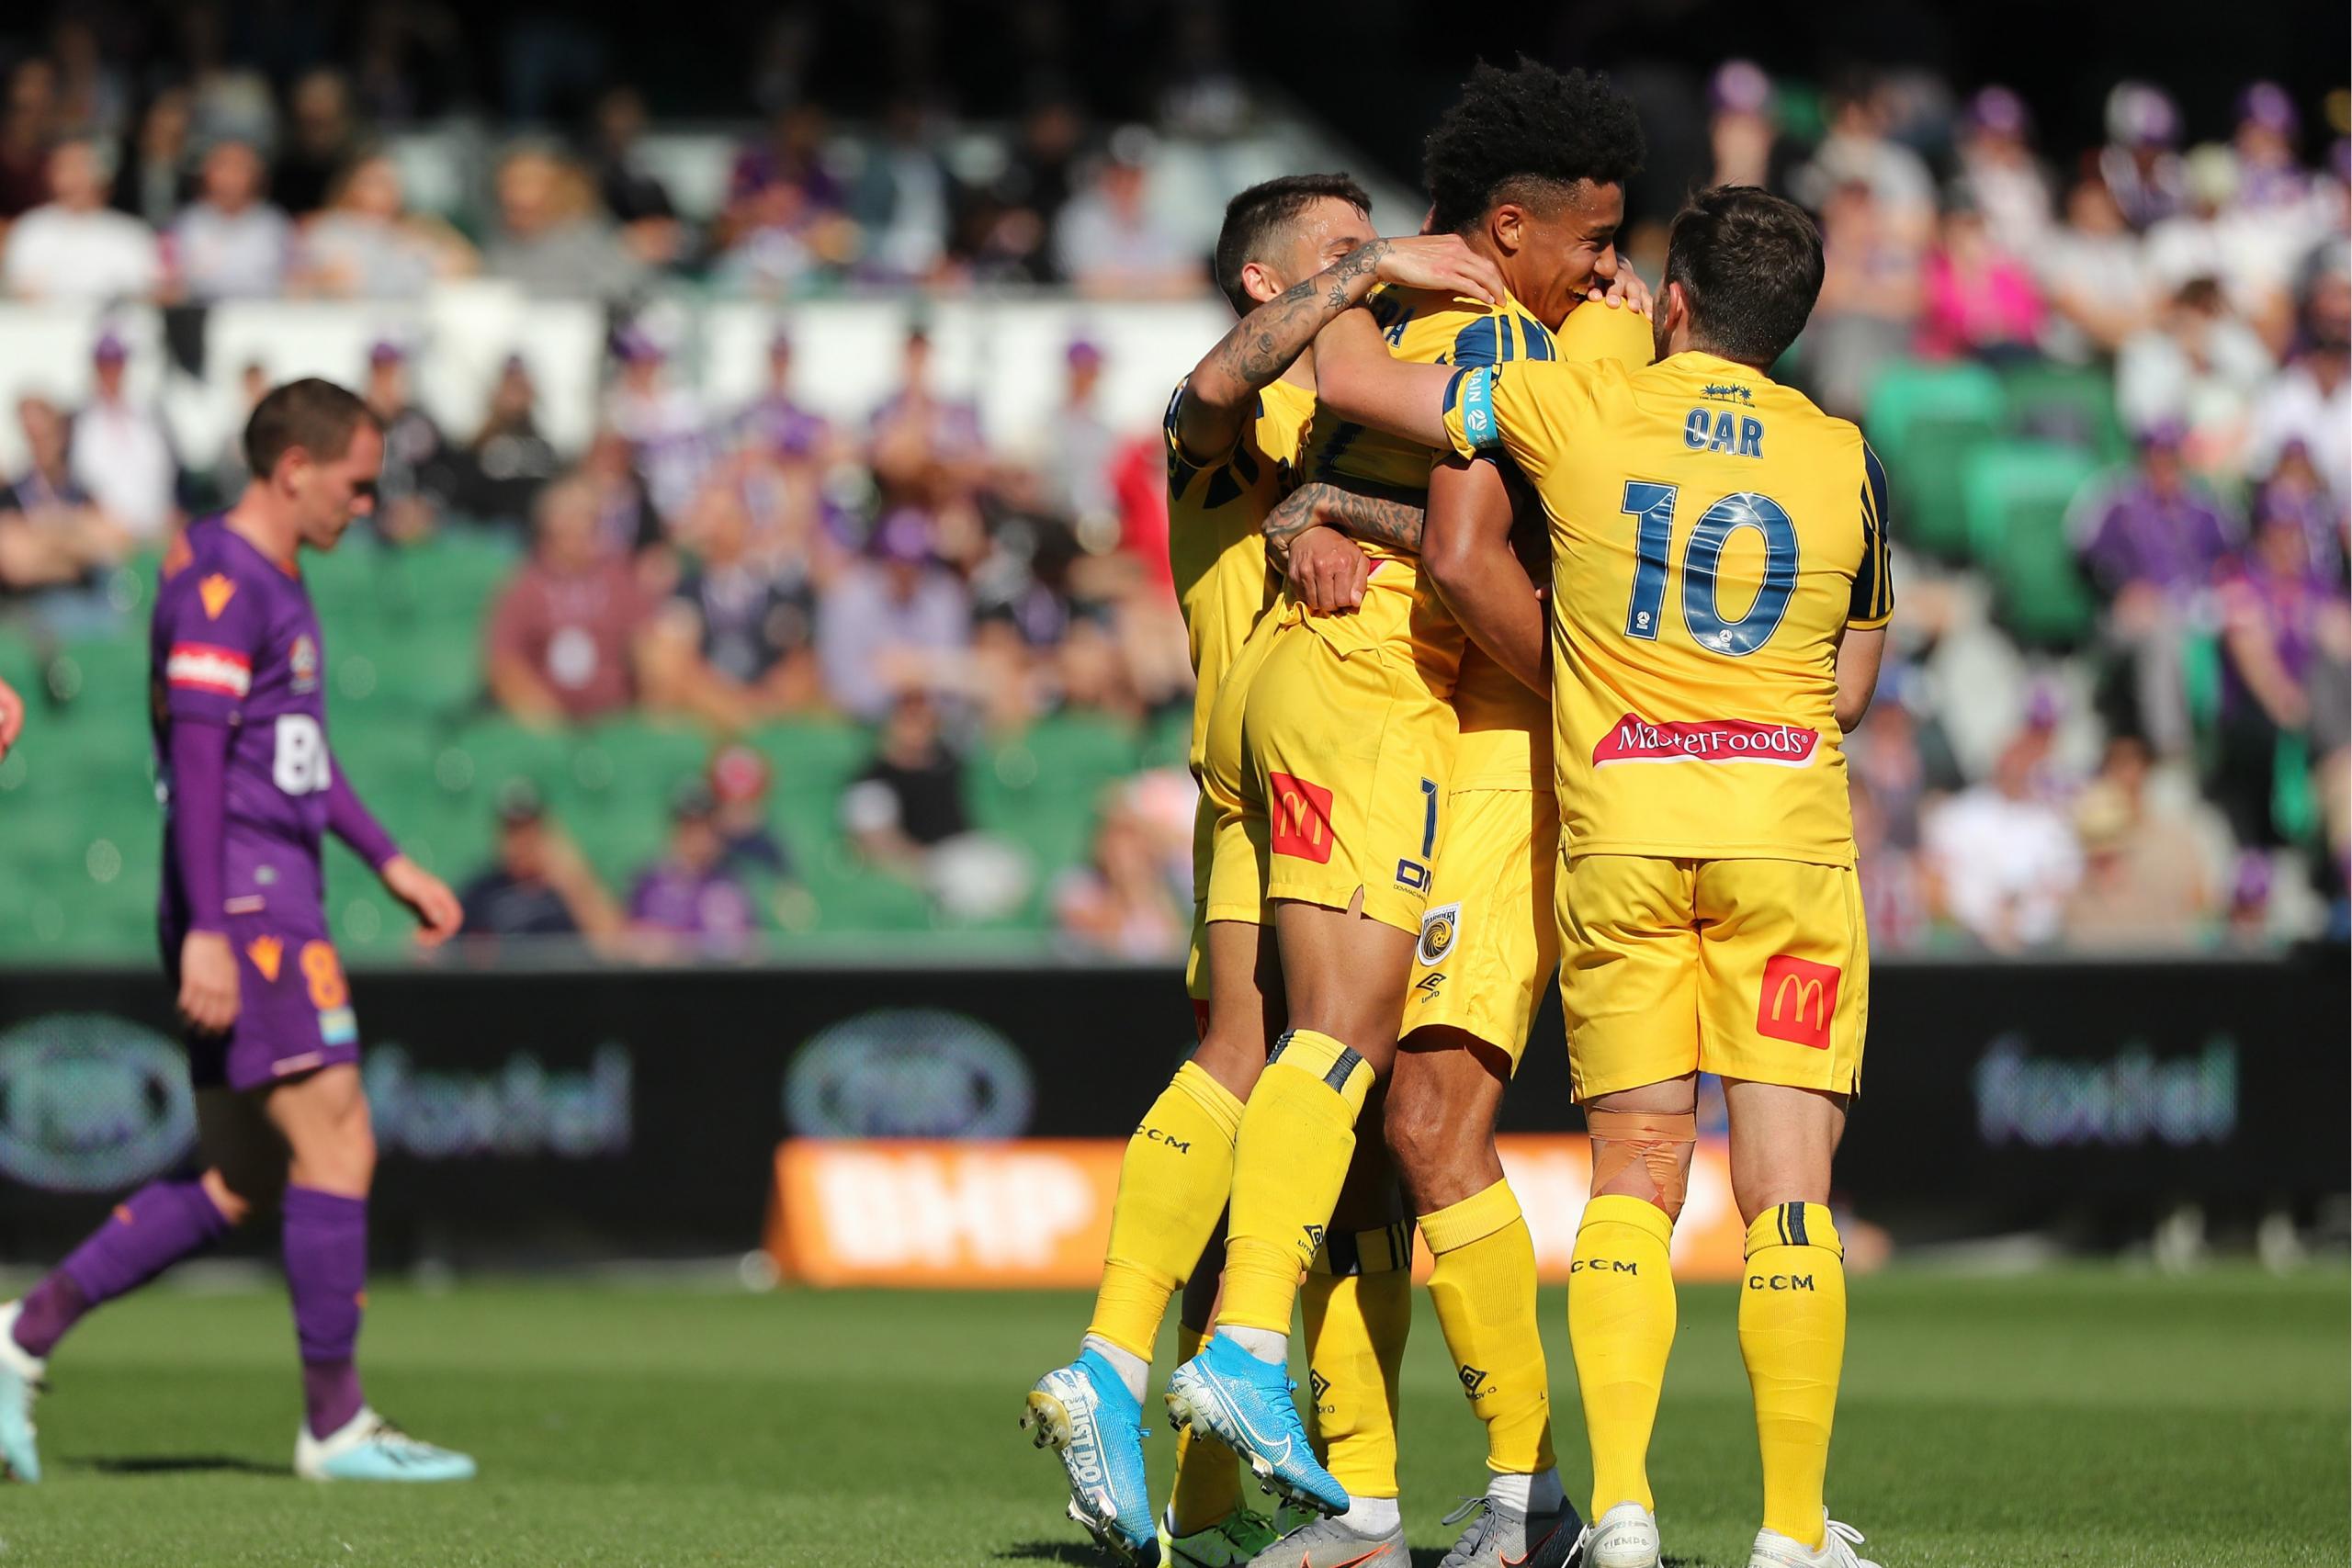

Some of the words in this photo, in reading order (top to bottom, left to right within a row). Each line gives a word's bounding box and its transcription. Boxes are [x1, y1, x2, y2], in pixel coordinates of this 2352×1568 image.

[1684, 407, 1763, 458] OAR
[1621, 480, 1800, 657] 10
[1135, 1124, 1191, 1155] CCM
[1570, 1258, 1637, 1276] CCM
[1749, 1274, 1815, 1292] CCM
